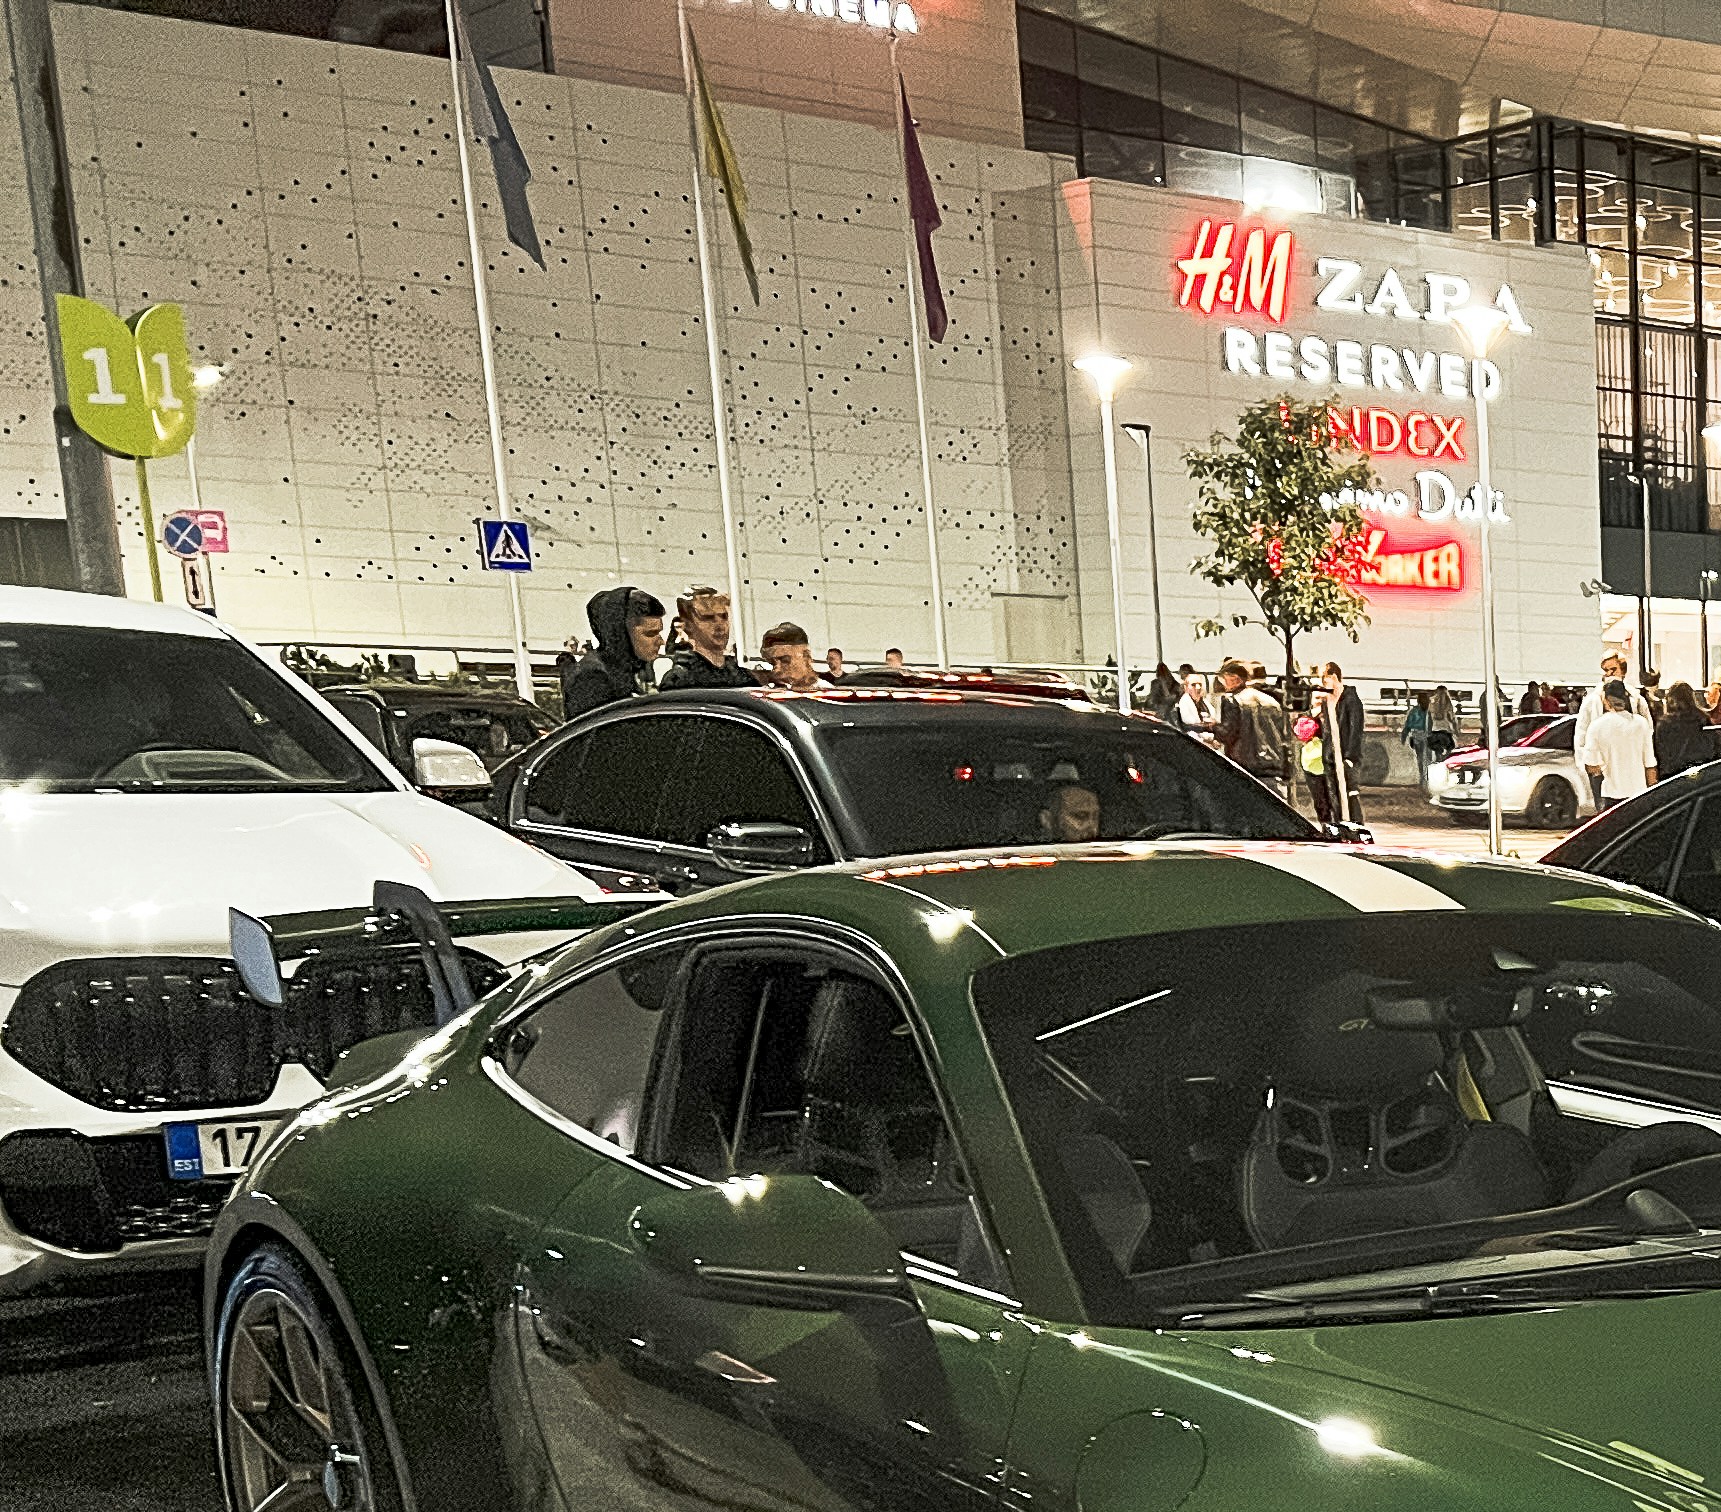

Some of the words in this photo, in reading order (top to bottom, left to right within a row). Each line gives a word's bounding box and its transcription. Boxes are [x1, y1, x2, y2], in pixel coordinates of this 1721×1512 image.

[1177, 220, 1292, 323] H&M
[82, 347, 127, 405] 1
[152, 353, 183, 409] 1
[1224, 327, 1500, 399] RESERVED
[174, 1158, 200, 1172] EST
[212, 1126, 262, 1168] 17
